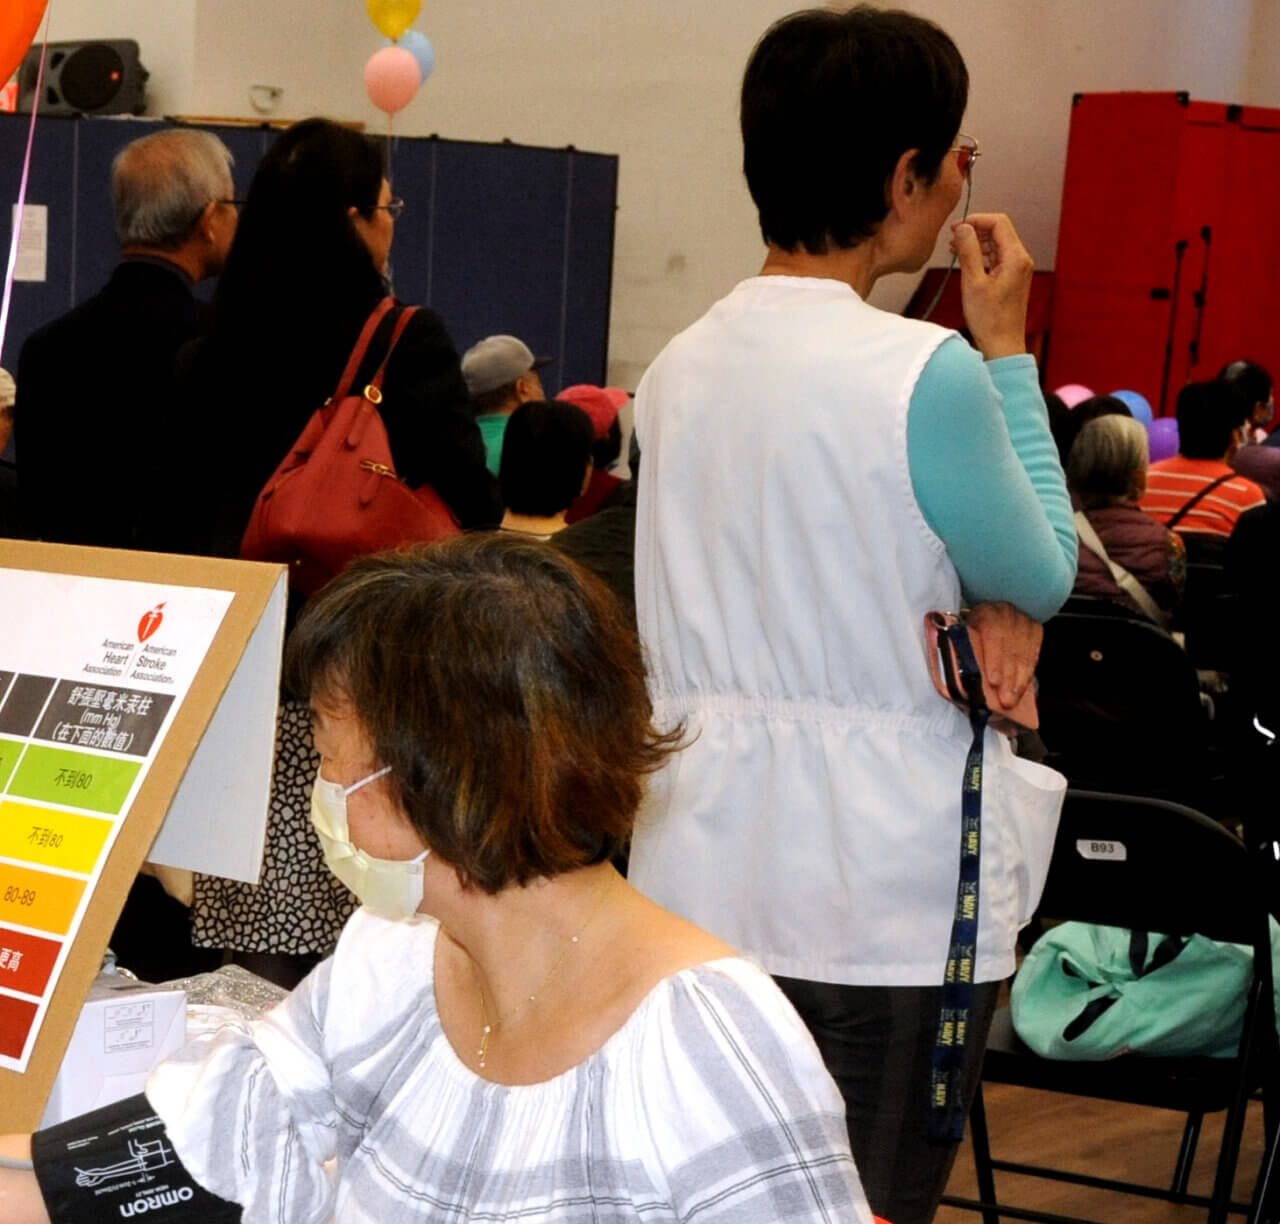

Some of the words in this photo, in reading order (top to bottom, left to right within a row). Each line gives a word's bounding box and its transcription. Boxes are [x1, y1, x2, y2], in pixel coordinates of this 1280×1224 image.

[102, 639, 135, 651] American
[143, 644, 177, 657] American
[103, 652, 129, 665] Heart
[136, 655, 166, 670] Stroke
[83, 663, 122, 677] Association
[54, 767, 93, 790] 不到80
[27, 826, 64, 849] 不到80
[967, 831, 979, 856] NAVY
[1090, 842, 1115, 853] B93
[3, 886, 36, 906] 80-89
[963, 895, 977, 920] NAVY
[959, 958, 972, 983] NAVY
[935, 1083, 946, 1107] NAVY
